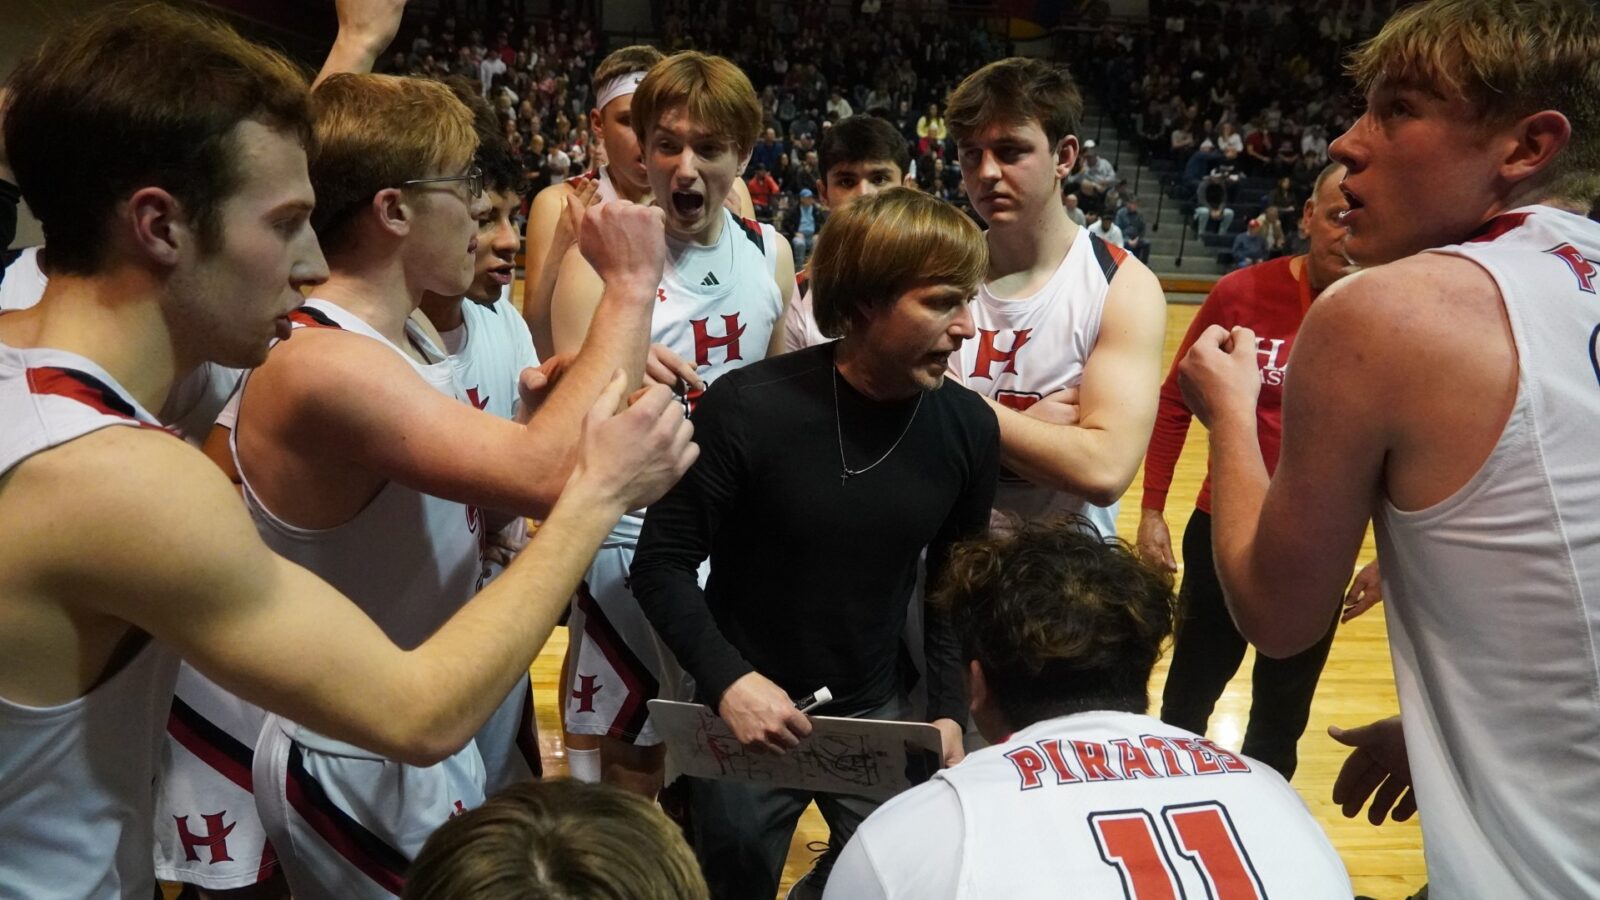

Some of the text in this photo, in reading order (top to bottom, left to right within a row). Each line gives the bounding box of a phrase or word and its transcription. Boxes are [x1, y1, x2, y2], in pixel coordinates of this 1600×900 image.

[689, 311, 747, 366] H
[969, 328, 1033, 380] H
[1255, 337, 1289, 371] H
[1003, 734, 1251, 791] PIRATES
[172, 810, 237, 865] H
[1087, 800, 1269, 900] 11
